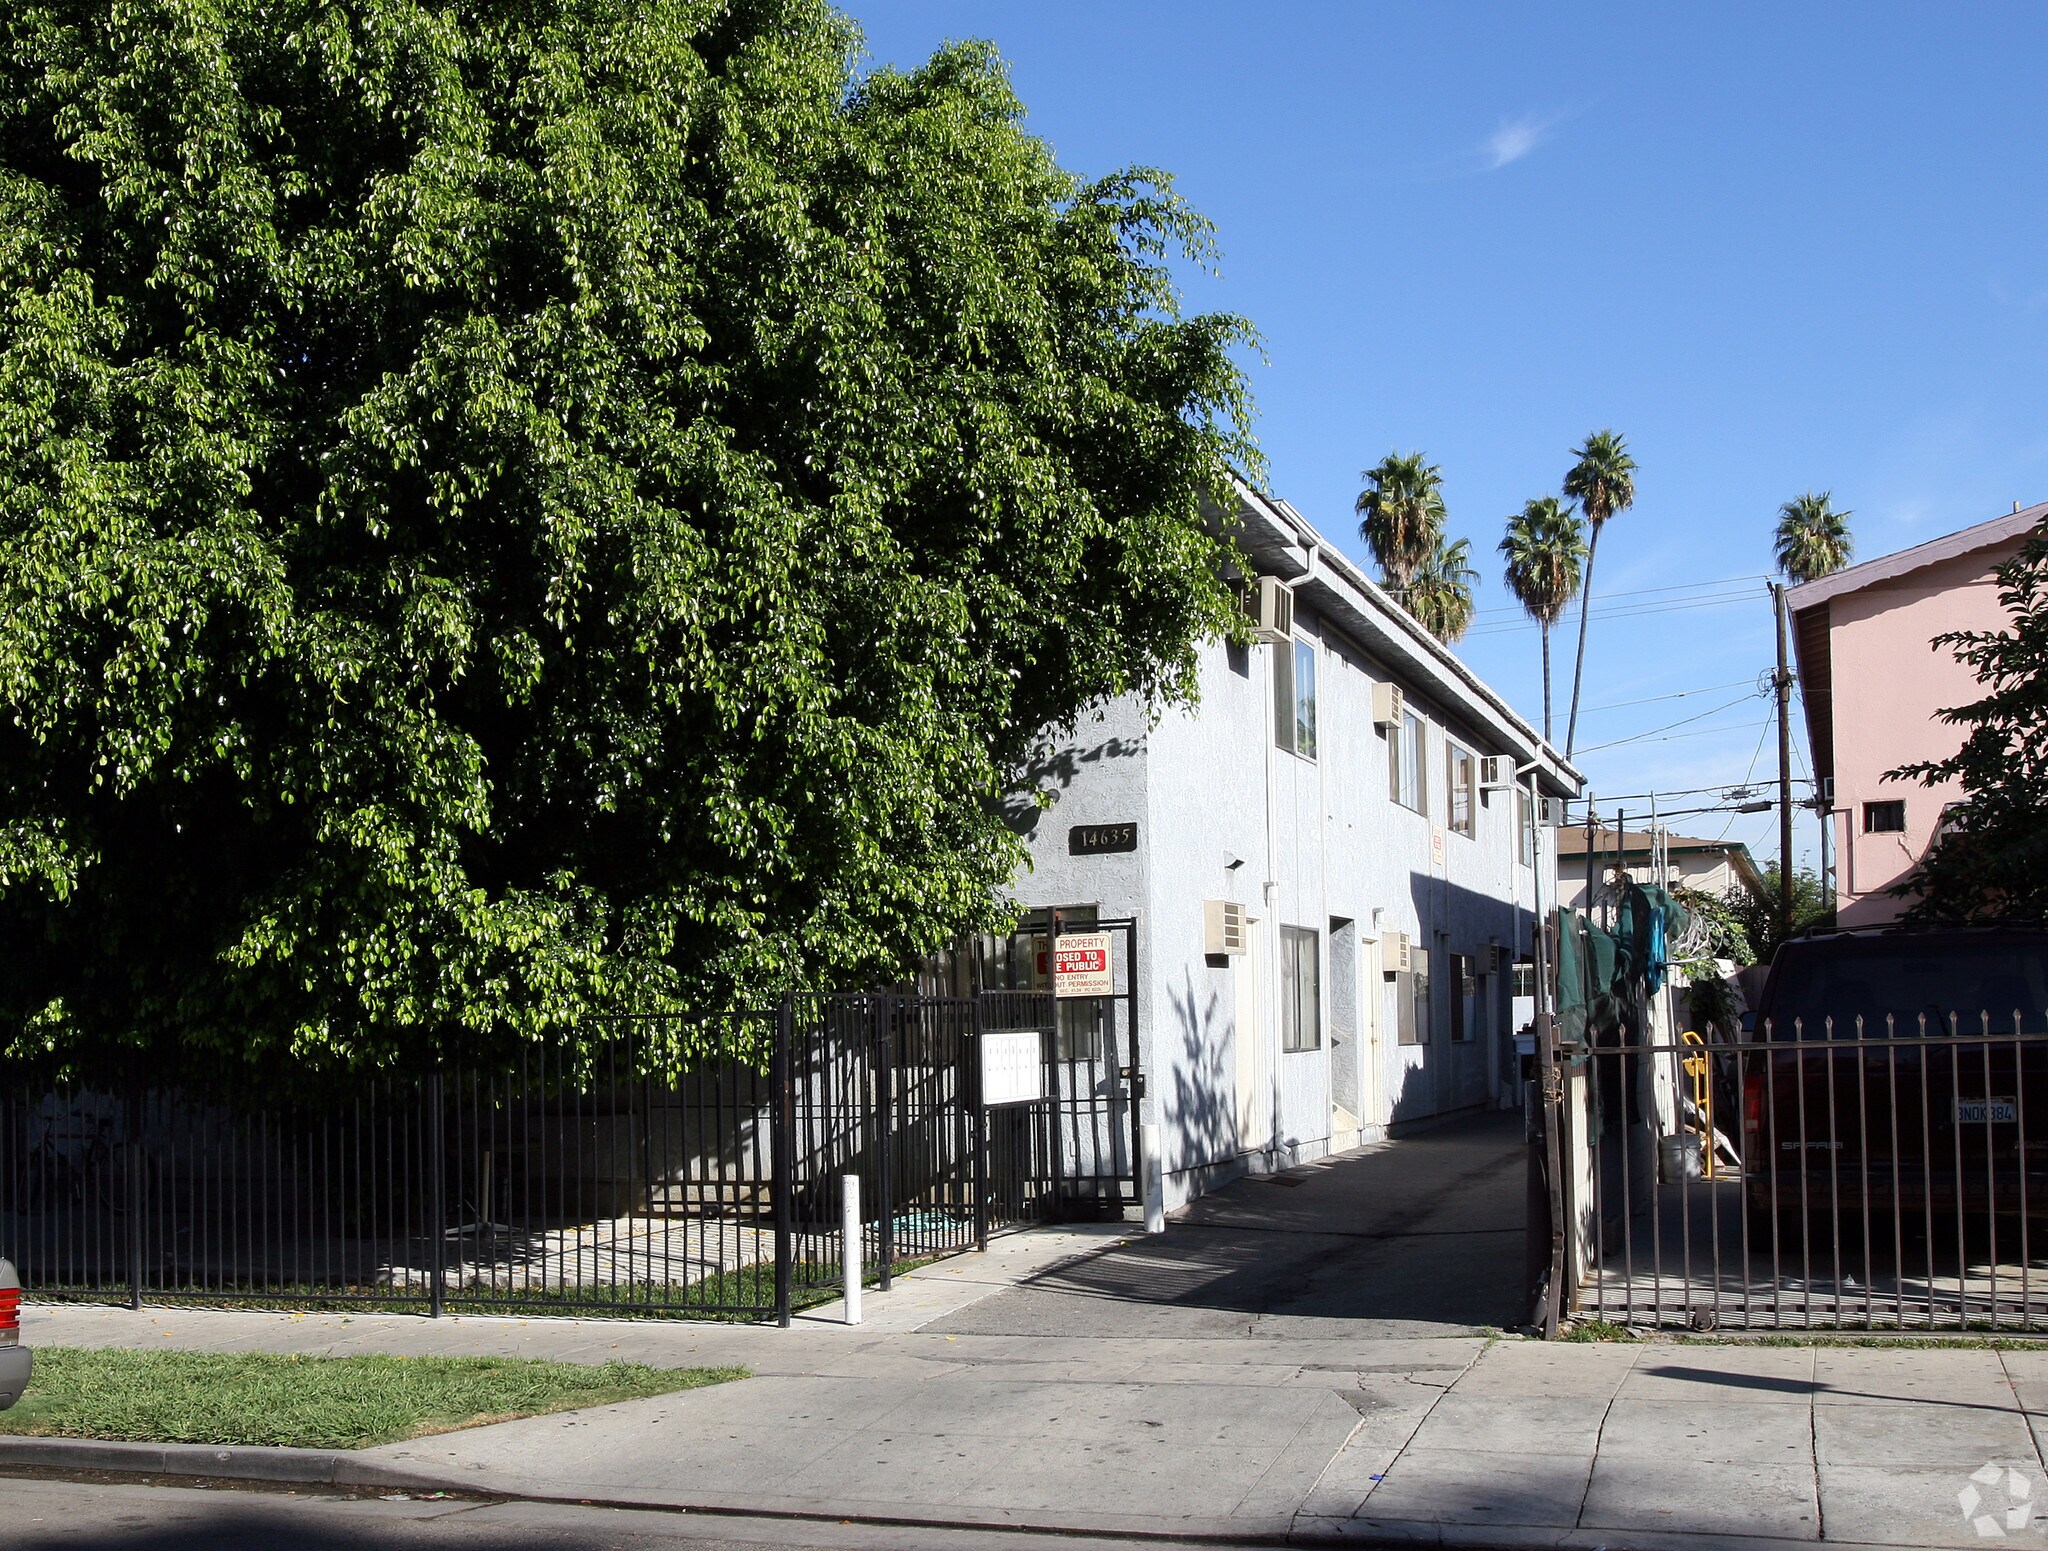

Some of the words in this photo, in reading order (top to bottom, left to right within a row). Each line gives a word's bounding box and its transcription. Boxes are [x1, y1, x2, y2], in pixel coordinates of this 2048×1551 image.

[1081, 828, 1131, 847] 14635
[1059, 938, 1105, 949] PROPERTY
[1056, 952, 1081, 962] OSED
[1085, 951, 1098, 961] TO
[1066, 961, 1099, 972] PUBLIC
[1067, 973, 1089, 981] ENTRY
[1068, 979, 1109, 988] PERMISSION
[1781, 1140, 1844, 1150] SAFARI
